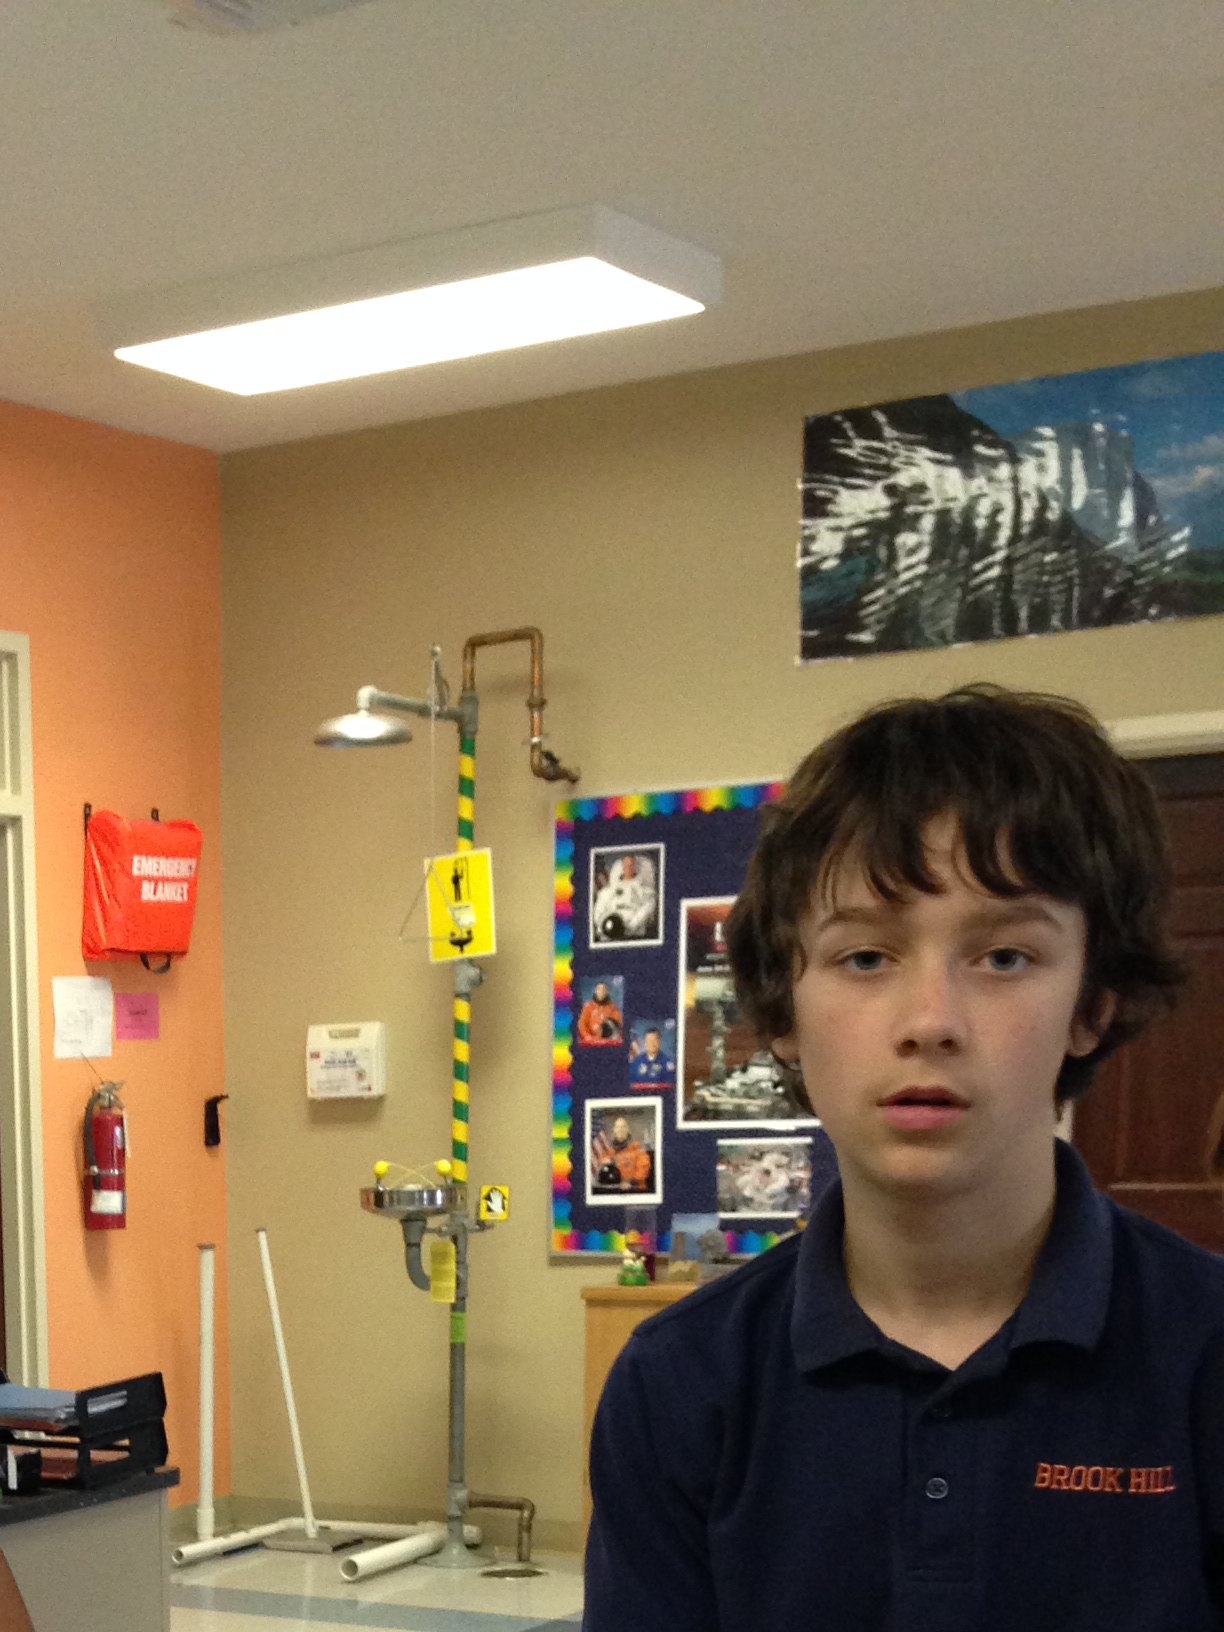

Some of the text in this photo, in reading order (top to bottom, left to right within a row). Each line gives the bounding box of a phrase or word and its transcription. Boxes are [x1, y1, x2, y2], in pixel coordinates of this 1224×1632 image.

[132, 855, 197, 878] EMERGENCY
[141, 880, 188, 902] BLANKET
[1034, 1462, 1176, 1494] BROOK HILL
